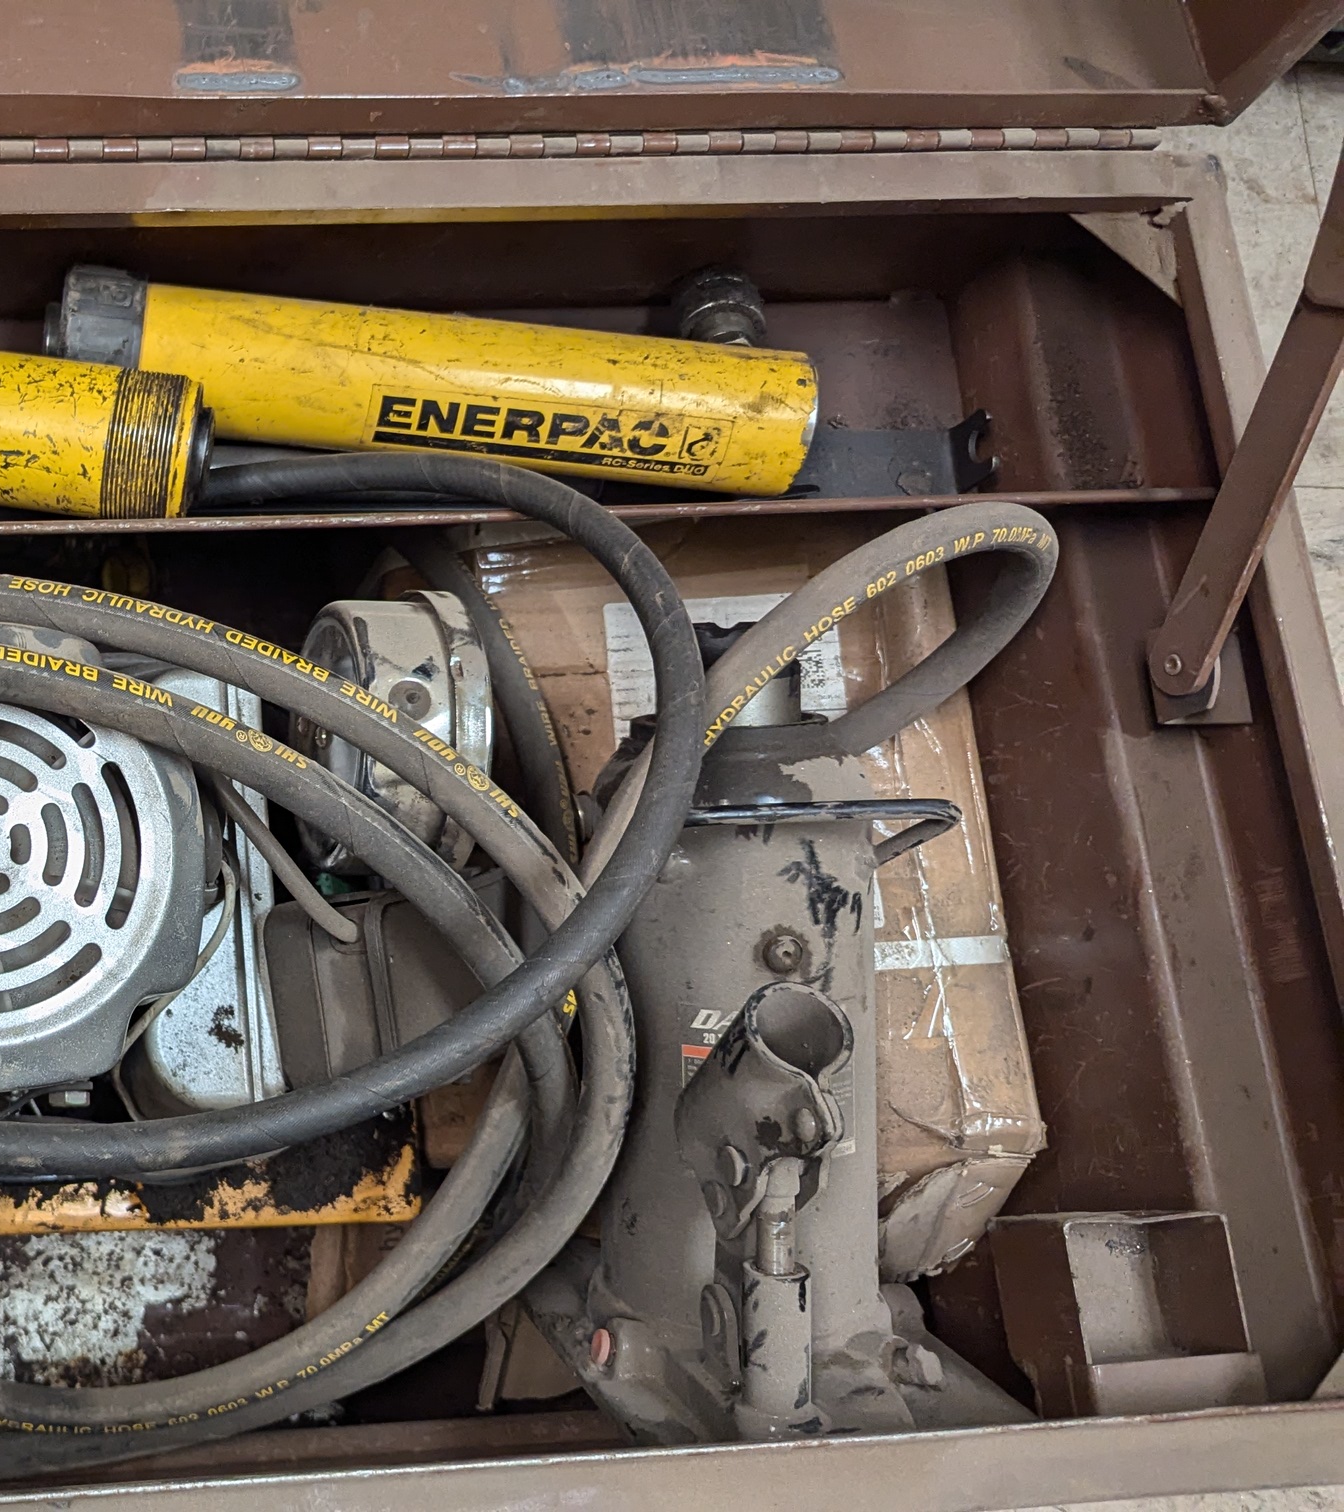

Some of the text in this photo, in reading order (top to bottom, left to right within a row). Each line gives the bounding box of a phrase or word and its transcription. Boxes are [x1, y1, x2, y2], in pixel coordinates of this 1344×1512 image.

[377, 395, 670, 457] ENERPAC
[8, 576, 72, 597] HOSE
[81, 588, 216, 634] HYDRAULIC
[225, 630, 331, 683] BRAIDED
[703, 645, 798, 747] HYDRAULIC
[803, 596, 857, 641] HOSE
[866, 571, 898, 600] 602
[905, 546, 945, 576] 0603
[112, 673, 174, 708] WIRE
[339, 679, 398, 723] WIRE
[273, 743, 310, 770] SHI
[488, 787, 520, 819] SHI
[364, 1310, 391, 1334] MT
